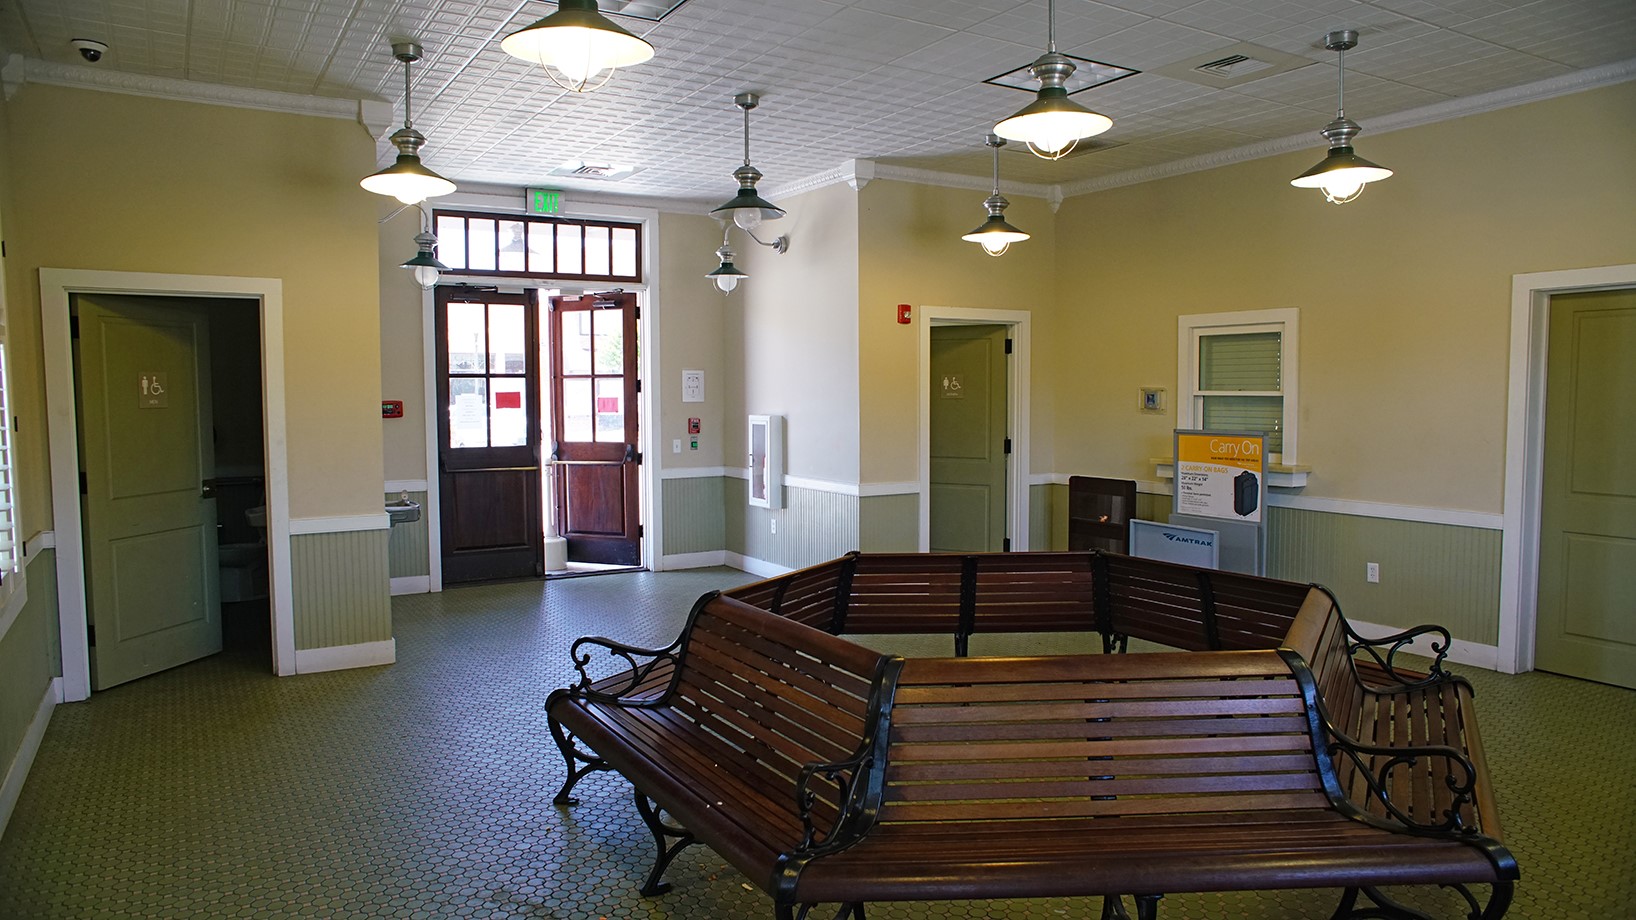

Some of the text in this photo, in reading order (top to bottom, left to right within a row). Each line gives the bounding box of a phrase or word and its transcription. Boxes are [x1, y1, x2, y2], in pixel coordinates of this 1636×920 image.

[535, 191, 559, 213] EXIT
[1210, 438, 1259, 458] Carry On
[1213, 466, 1229, 474] BAGS
[1175, 536, 1213, 547] AMTRAK
